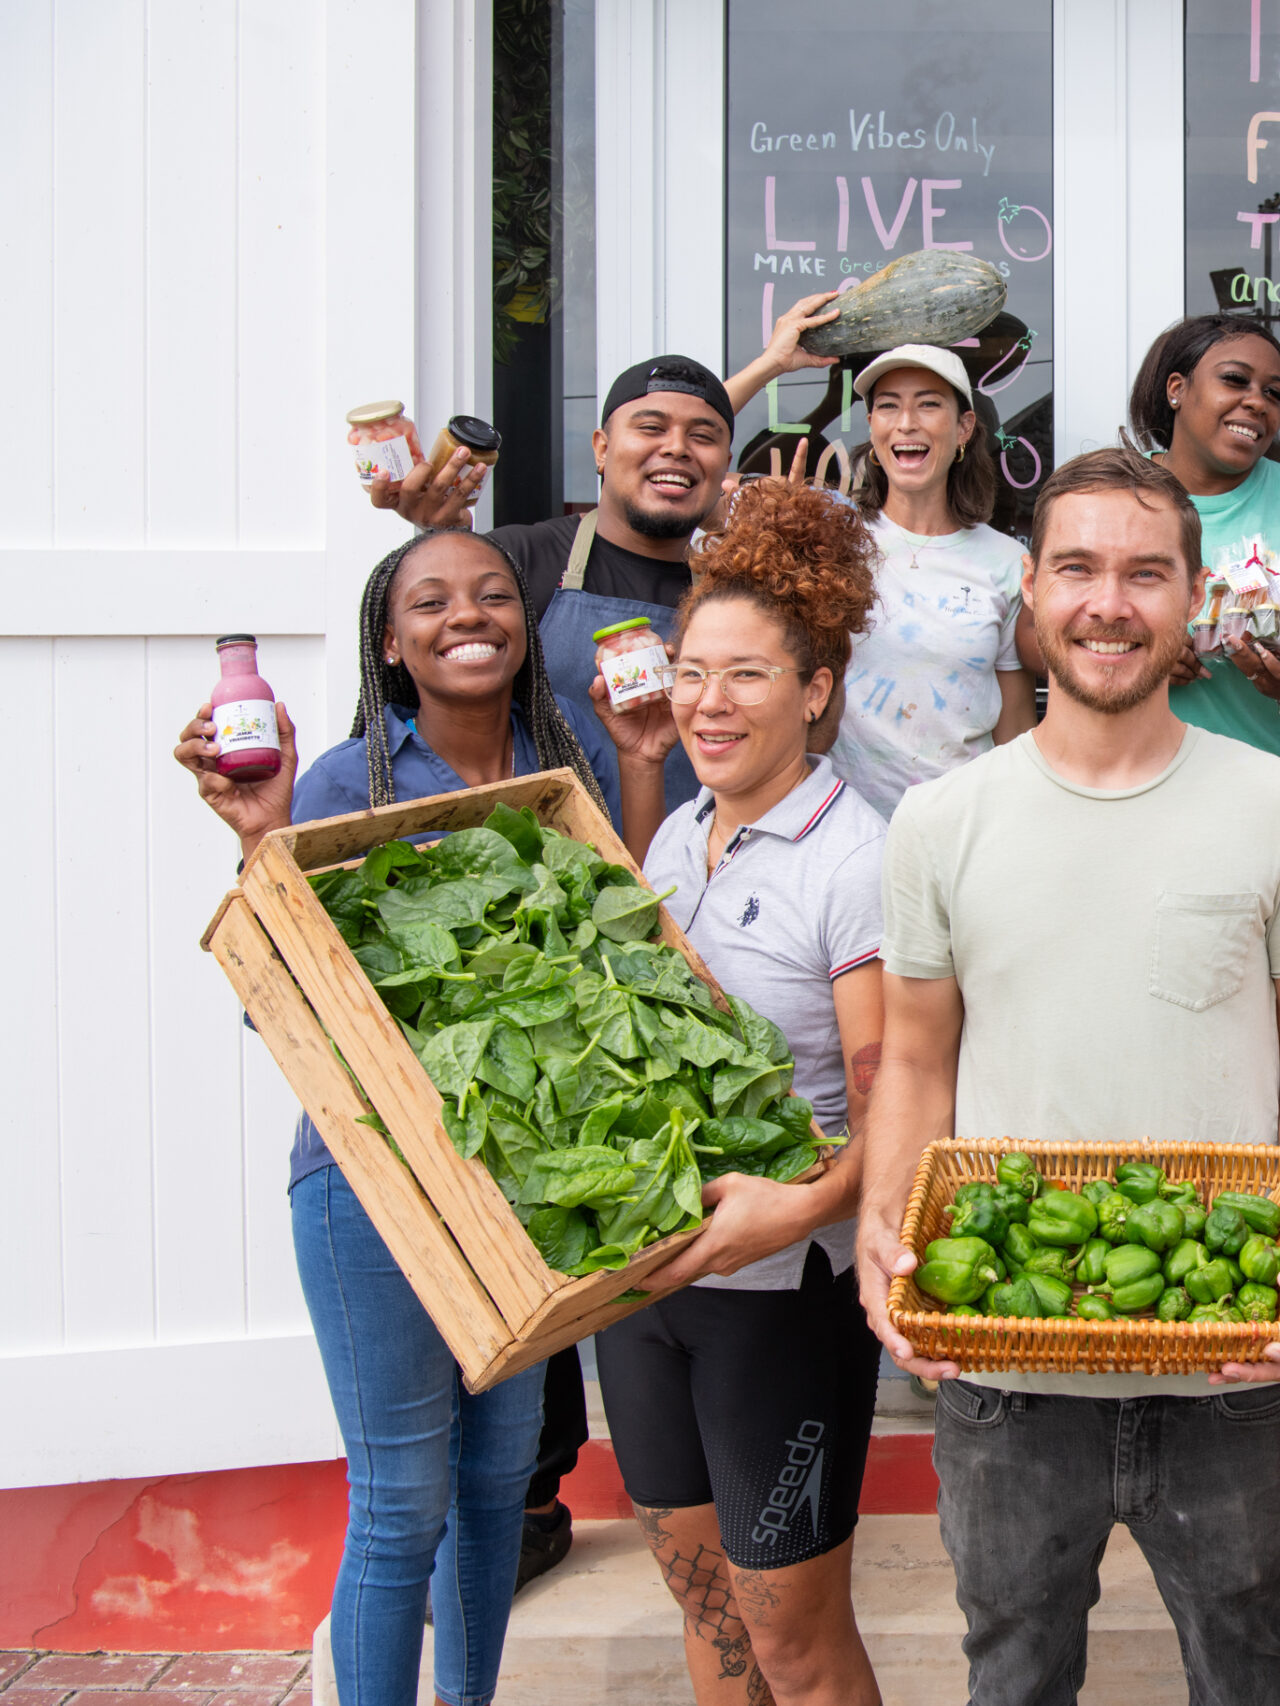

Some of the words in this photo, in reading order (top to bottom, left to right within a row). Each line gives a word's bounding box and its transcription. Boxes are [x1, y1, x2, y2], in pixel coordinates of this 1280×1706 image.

[750, 122, 836, 153] Green
[849, 109, 927, 152] Vibes
[935, 111, 996, 177] Only
[764, 175, 974, 252] LIVE
[753, 252, 827, 277] MAKE
[839, 257, 888, 274] Gree
[751, 1419, 825, 1547] speedo
